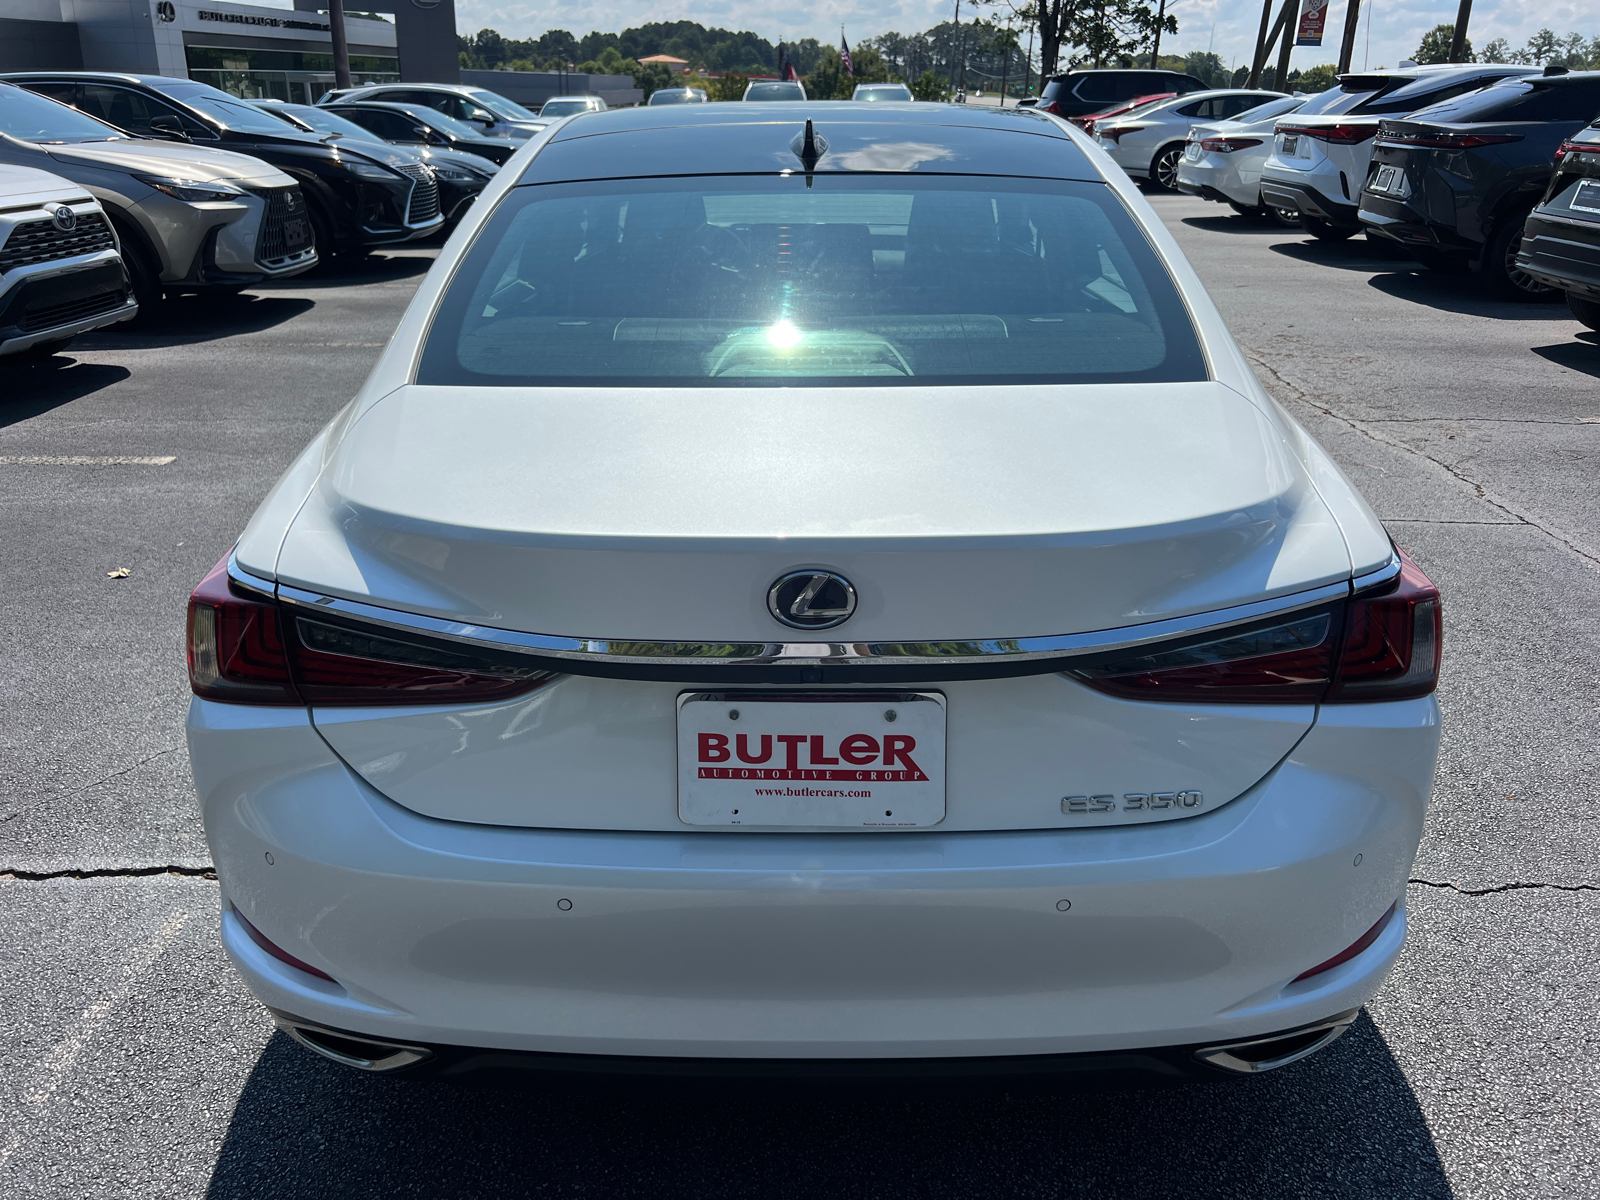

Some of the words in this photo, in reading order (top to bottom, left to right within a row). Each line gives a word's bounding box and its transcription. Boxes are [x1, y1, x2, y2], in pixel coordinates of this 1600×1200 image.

[699, 769, 833, 780] AUTOMOTIVE
[856, 771, 921, 780] GROUP
[755, 787, 872, 798] www.butlercars.com
[1061, 794, 1116, 814] ES
[1124, 789, 1203, 811] 350
